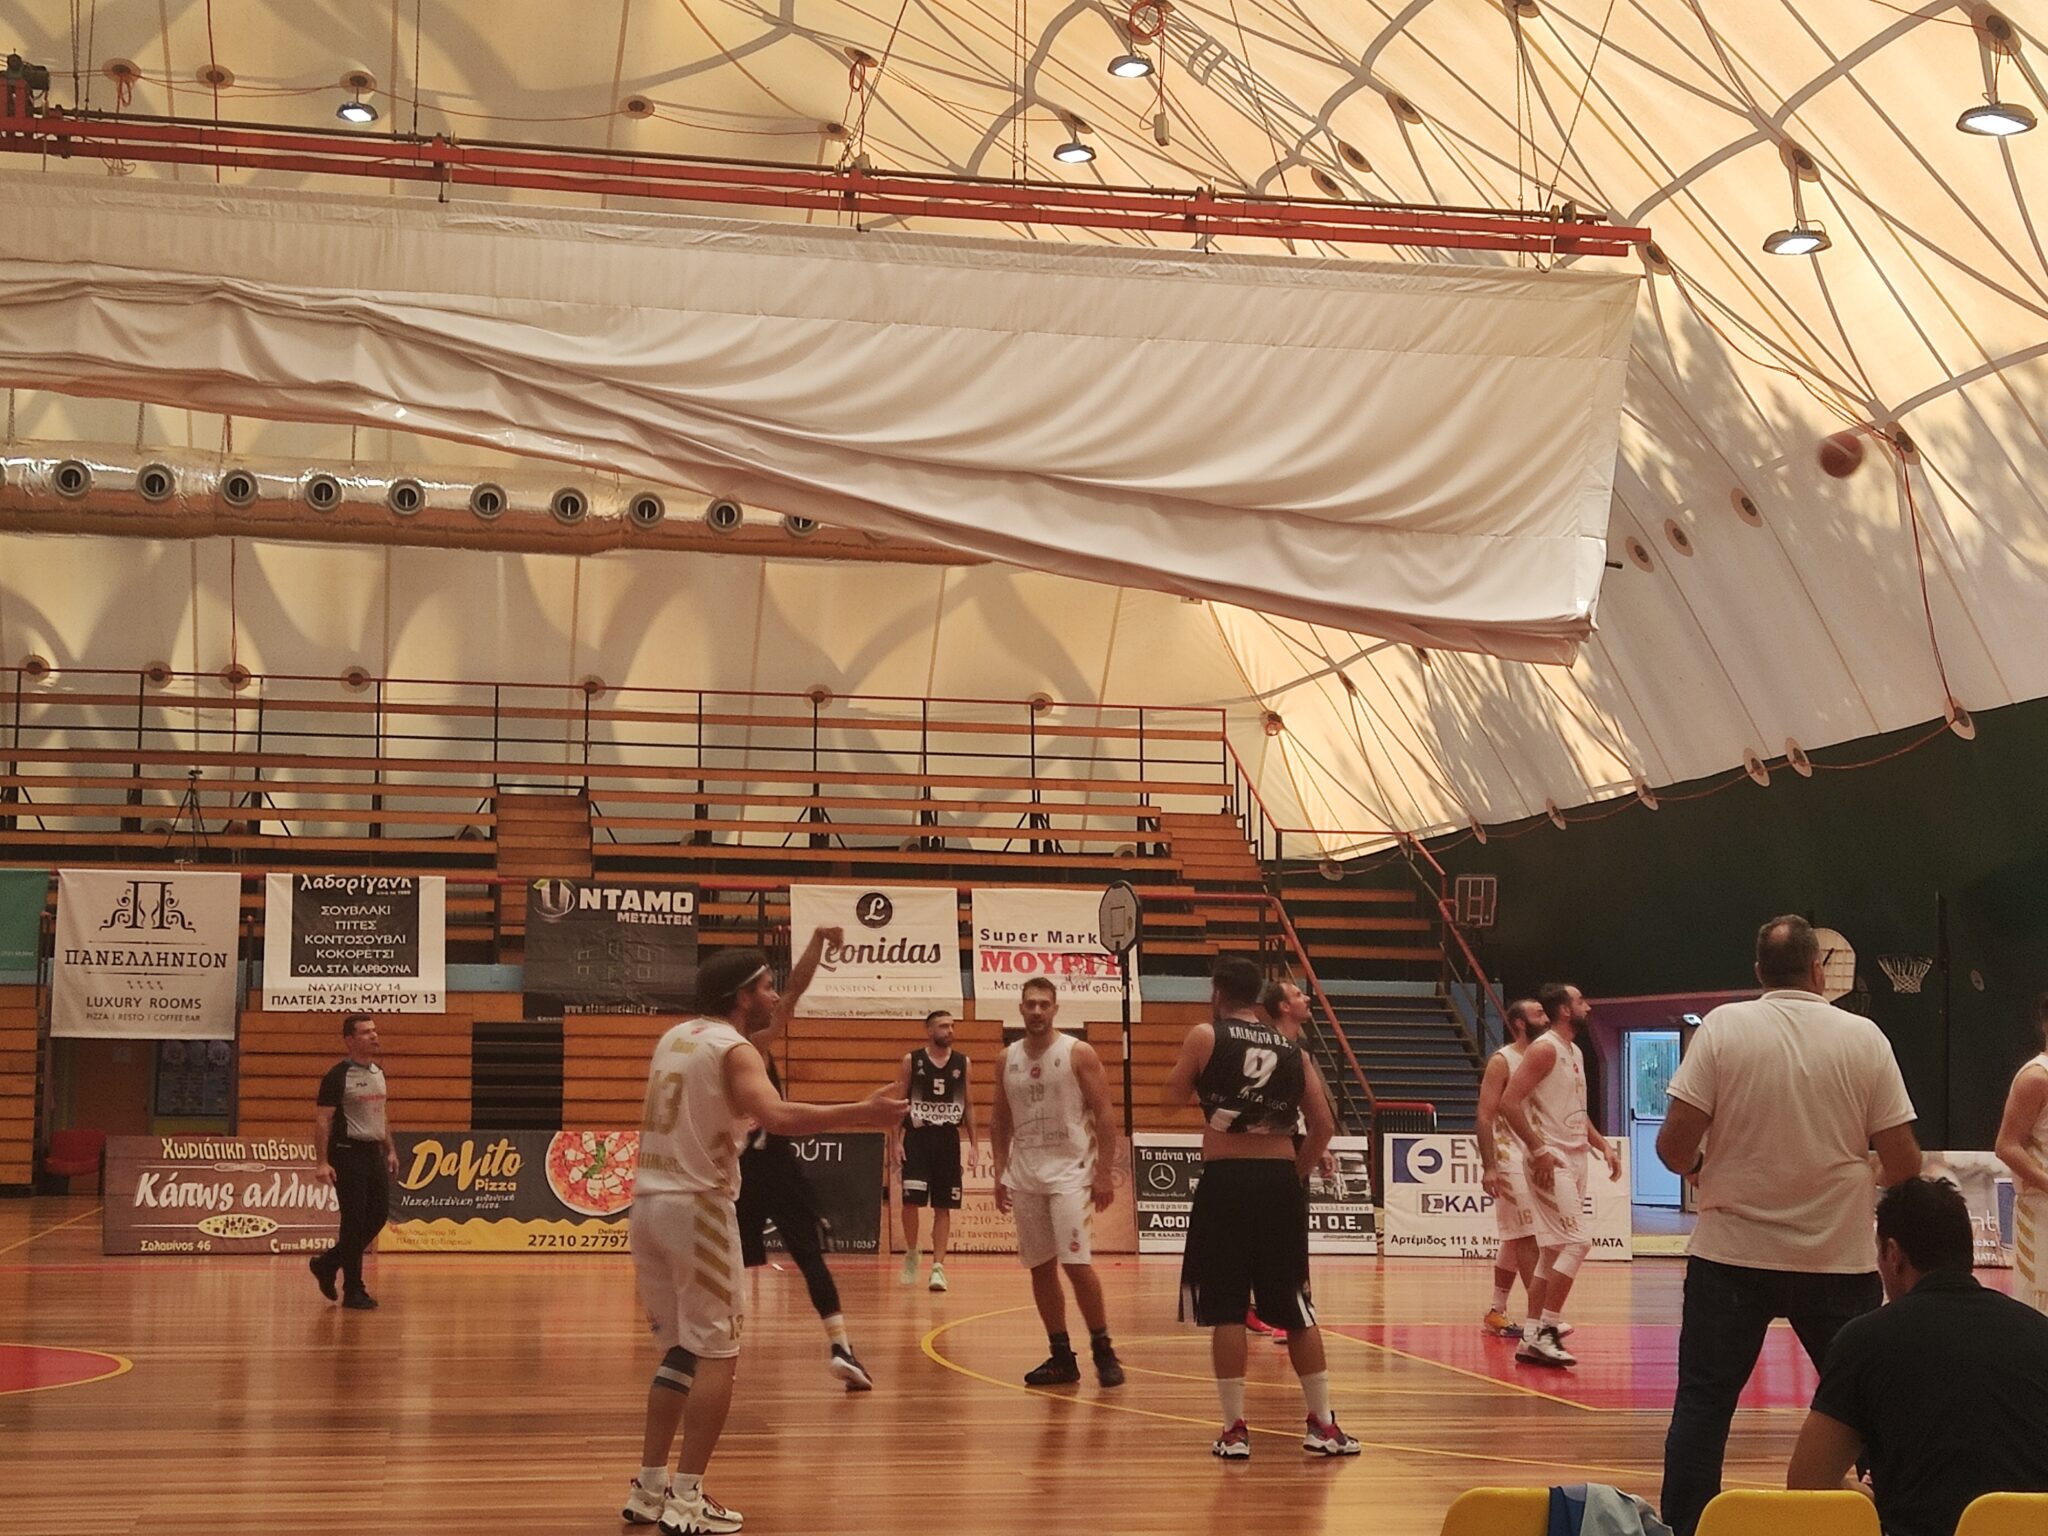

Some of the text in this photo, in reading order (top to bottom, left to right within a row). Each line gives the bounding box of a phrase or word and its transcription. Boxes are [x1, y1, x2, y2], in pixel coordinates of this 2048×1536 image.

[579, 888, 694, 913] NTAMO
[320, 905, 391, 917] ΣΟΥΒΛΑΚΙ
[334, 920, 377, 931] ΠΙΤΕΣ
[617, 912, 692, 926] METALTEK
[304, 934, 407, 945] ΚΟΝΤΟΣΟΥΒΛΙ
[980, 928, 1098, 944] Super Mark
[63, 949, 228, 969] ΠΑΝΕΛΛΗΝΙΟΝ
[315, 949, 395, 959] ΚΟΚΟΡΕΤΣΙ
[298, 964, 412, 975] ΟΛΑ ΣΤΑ ΚΑΡΒΟΥΝΑ
[308, 982, 401, 992] ΝΑΥΑΡΙΝΟΥ 14
[86, 996, 202, 1010] LUXURY ROOMS
[271, 994, 326, 1006] ΠΛΑΤΕΙΑ
[360, 994, 418, 1005] ΜΑΡΤΙΟΥ
[423, 993, 437, 1004] 13
[86, 1012, 109, 1020] PIZZA
[119, 1013, 145, 1021] RESTO
[153, 1014, 183, 1022] COFFEE
[1242, 1047, 1278, 1093] 9
[932, 1078, 946, 1096] 5
[914, 1102, 962, 1113] TOYOTA
[161, 1138, 318, 1160] Χωριάτικη ταβέρνα
[1140, 1149, 1202, 1164] Τα πάντα για
[398, 1138, 525, 1191] DaVito
[134, 1171, 235, 1211] Κάπως
[474, 1178, 518, 1191] Pizza
[951, 1187, 962, 1201] 5
[1327, 1215, 1362, 1230] Ο.Ε.
[196, 1240, 211, 1251] 46
[528, 1234, 629, 1248] 27210 27797
[1391, 1234, 1624, 1249] Αρτέμιδος 111 & Μπ ΜΑΤΑ
[1486, 1249, 1499, 1259] 27
